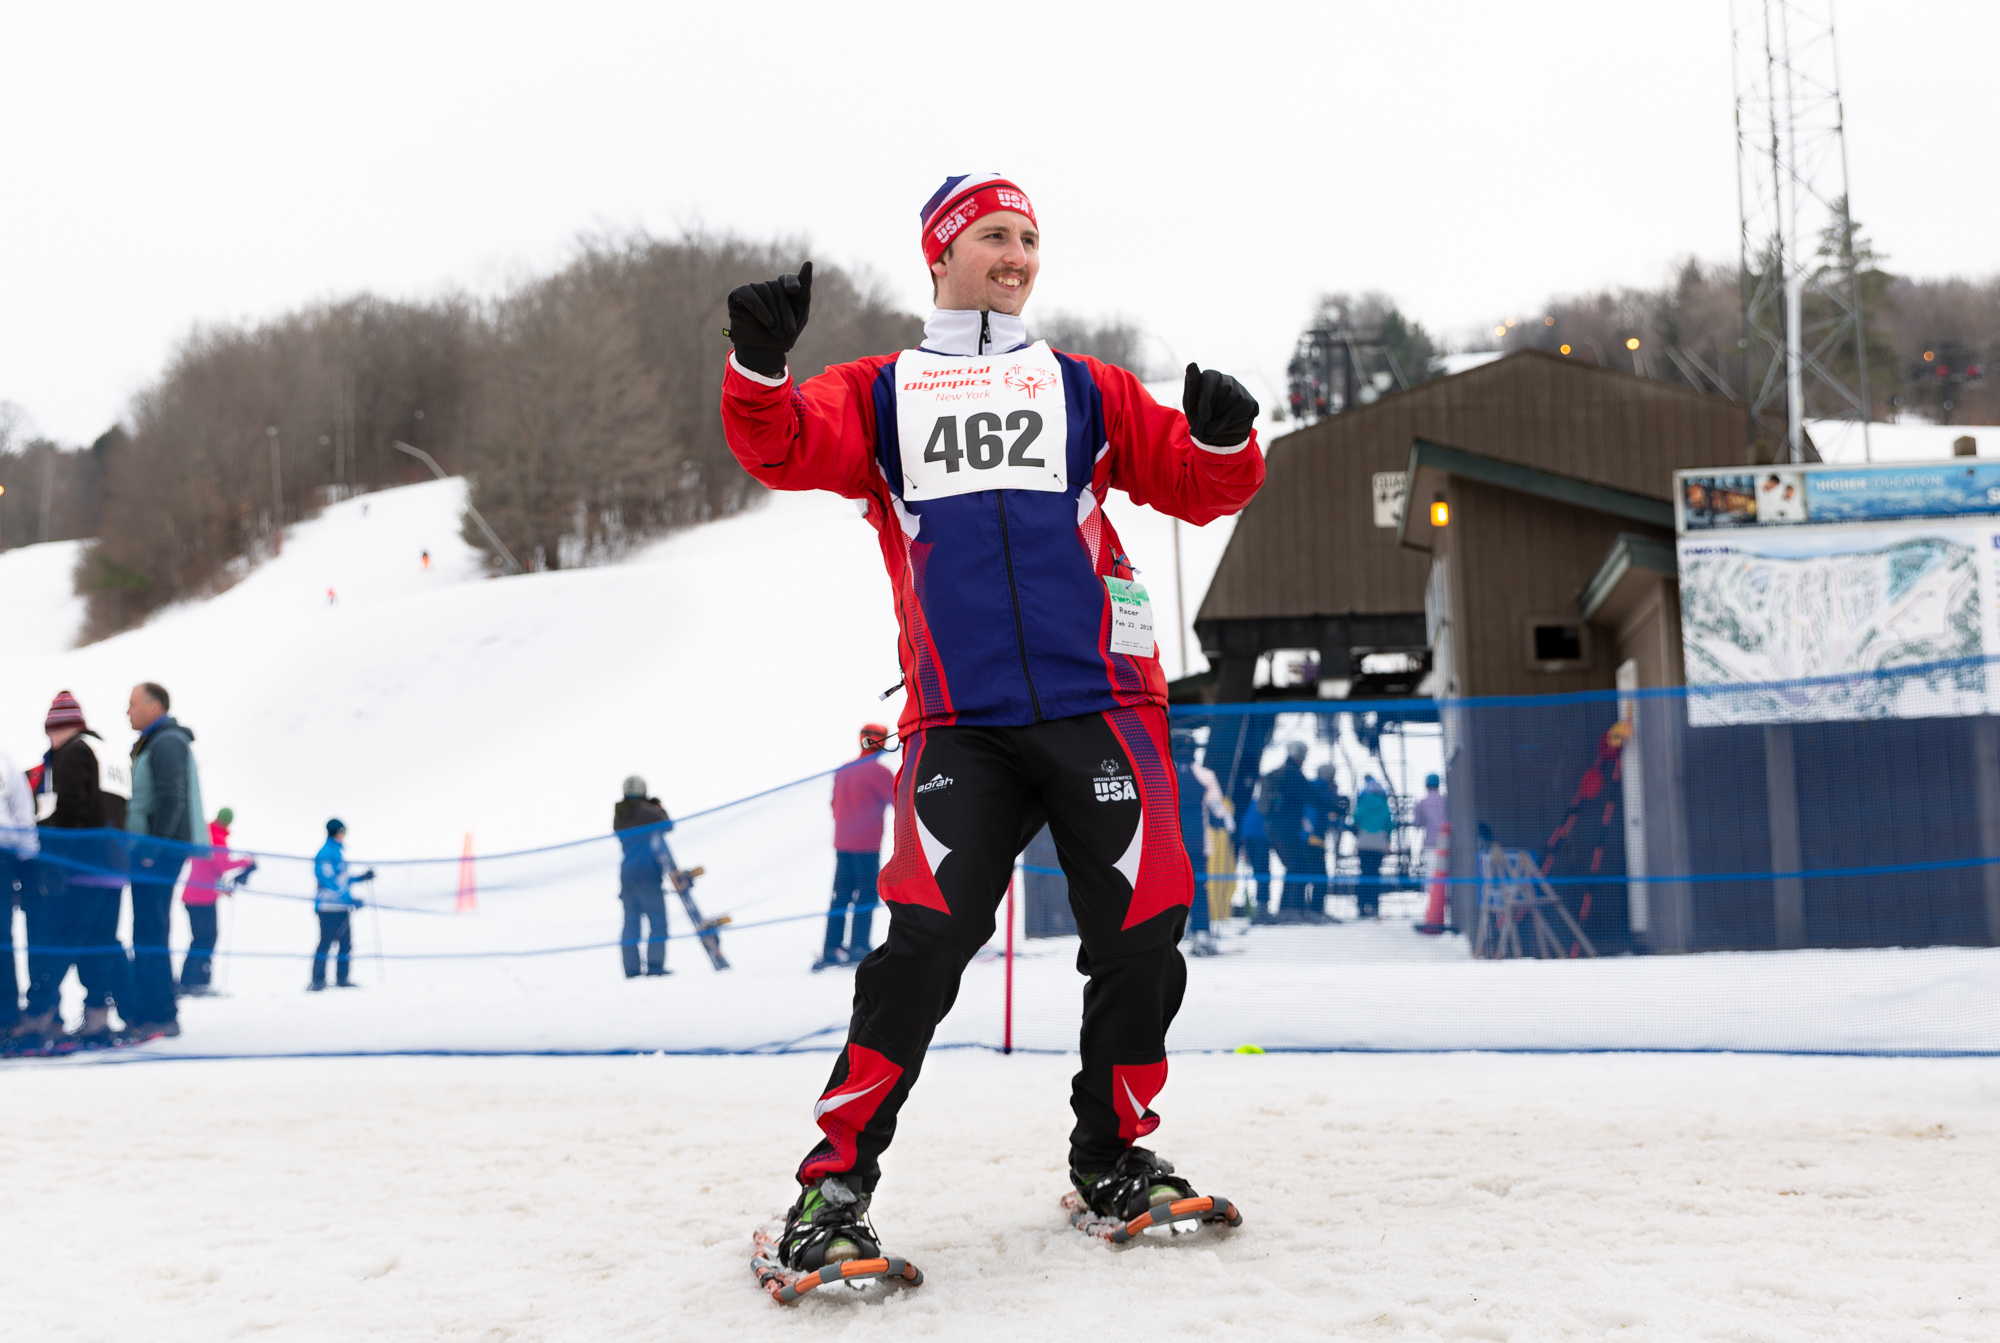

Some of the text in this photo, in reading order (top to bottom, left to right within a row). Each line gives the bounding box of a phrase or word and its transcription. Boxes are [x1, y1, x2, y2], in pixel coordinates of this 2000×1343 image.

[997, 193, 1030, 214] USA
[936, 213, 967, 244] USA
[922, 366, 991, 378] Special
[904, 378, 991, 391] Olympics
[936, 390, 991, 402] New York
[924, 409, 1045, 474] 462
[1816, 476, 1868, 492] HIGHER
[1119, 606, 1139, 616] Racer
[1115, 619, 1126, 627] Feb
[1094, 780, 1137, 802] USA
